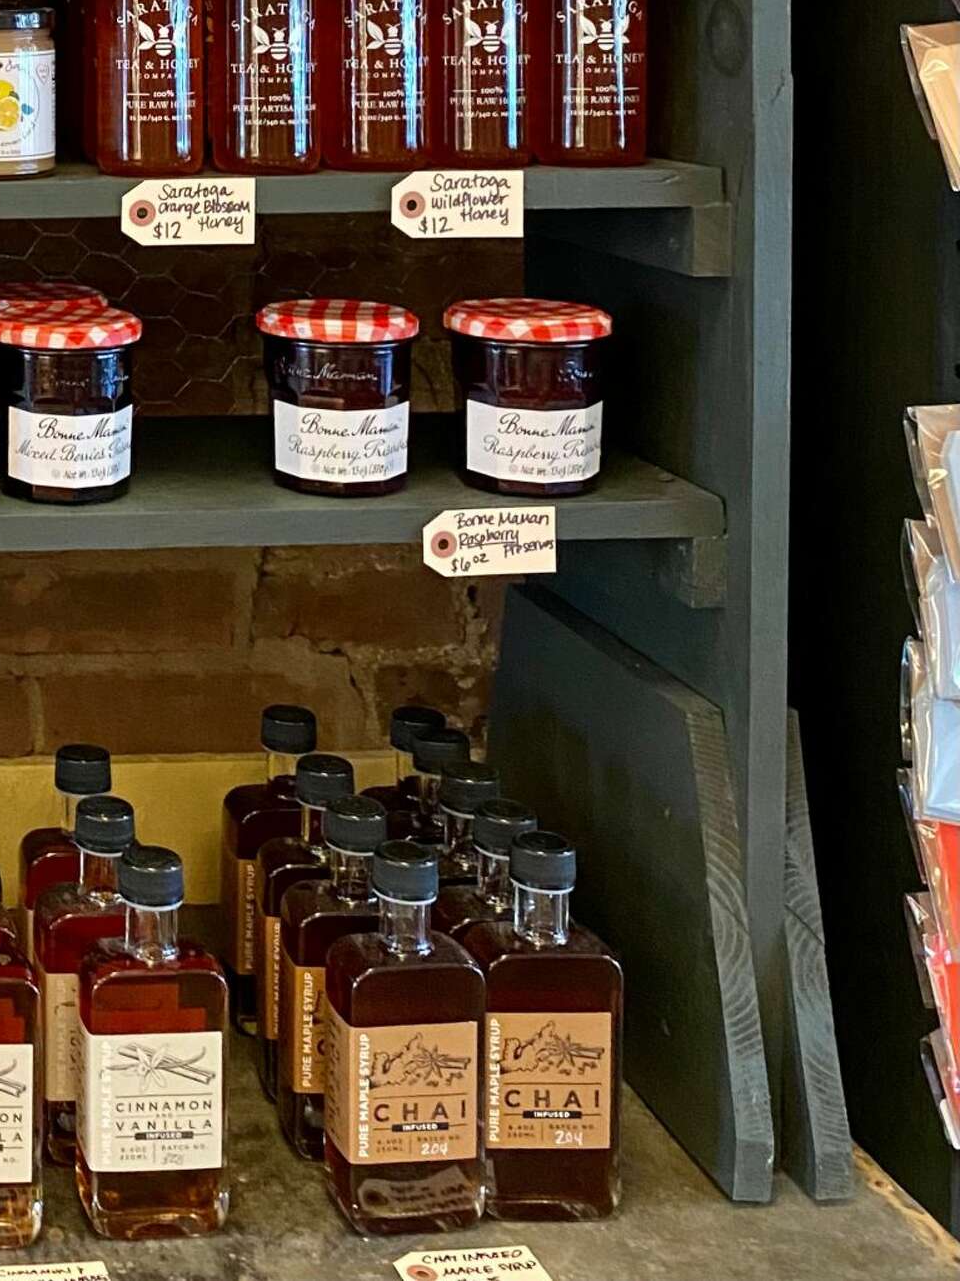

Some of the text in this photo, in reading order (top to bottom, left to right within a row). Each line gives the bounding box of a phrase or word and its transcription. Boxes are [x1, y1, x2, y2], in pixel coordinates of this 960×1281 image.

[442, 54, 466, 66] TEA
[471, 55, 482, 66] &
[555, 53, 580, 64] TEA
[586, 54, 596, 64] &
[158, 183, 234, 200] Saratoga
[430, 173, 511, 195] Saratoga
[198, 216, 244, 234] Honey
[418, 216, 453, 234] $12
[460, 207, 509, 225] Honey
[153, 221, 182, 239] $12
[37, 417, 84, 441] Bonne
[300, 412, 351, 438] Bonne
[497, 413, 550, 438] Bonne
[14, 438, 106, 463] Mixed Berries
[483, 435, 560, 467] Raspberry
[454, 513, 494, 527] Bonne
[459, 529, 518, 549] Raspberry
[302, 972, 314, 1088] PURE MAPLE SYRUP
[489, 1018, 502, 1142] PURE MAPLE SYRUP
[358, 1034, 370, 1157] PURE MAPLE SYRUP
[504, 1089, 600, 1109] CHAI
[115, 1100, 213, 1113] CINNAMON
[374, 1099, 467, 1122] CHAI
[533, 1111, 570, 1119] INFUSED
[115, 1119, 213, 1131] VANILLA
[402, 1123, 438, 1131] INFUSED
[555, 1130, 583, 1146] 204
[421, 1141, 449, 1156] 204
[443, 1265, 493, 1277] MAPLE
